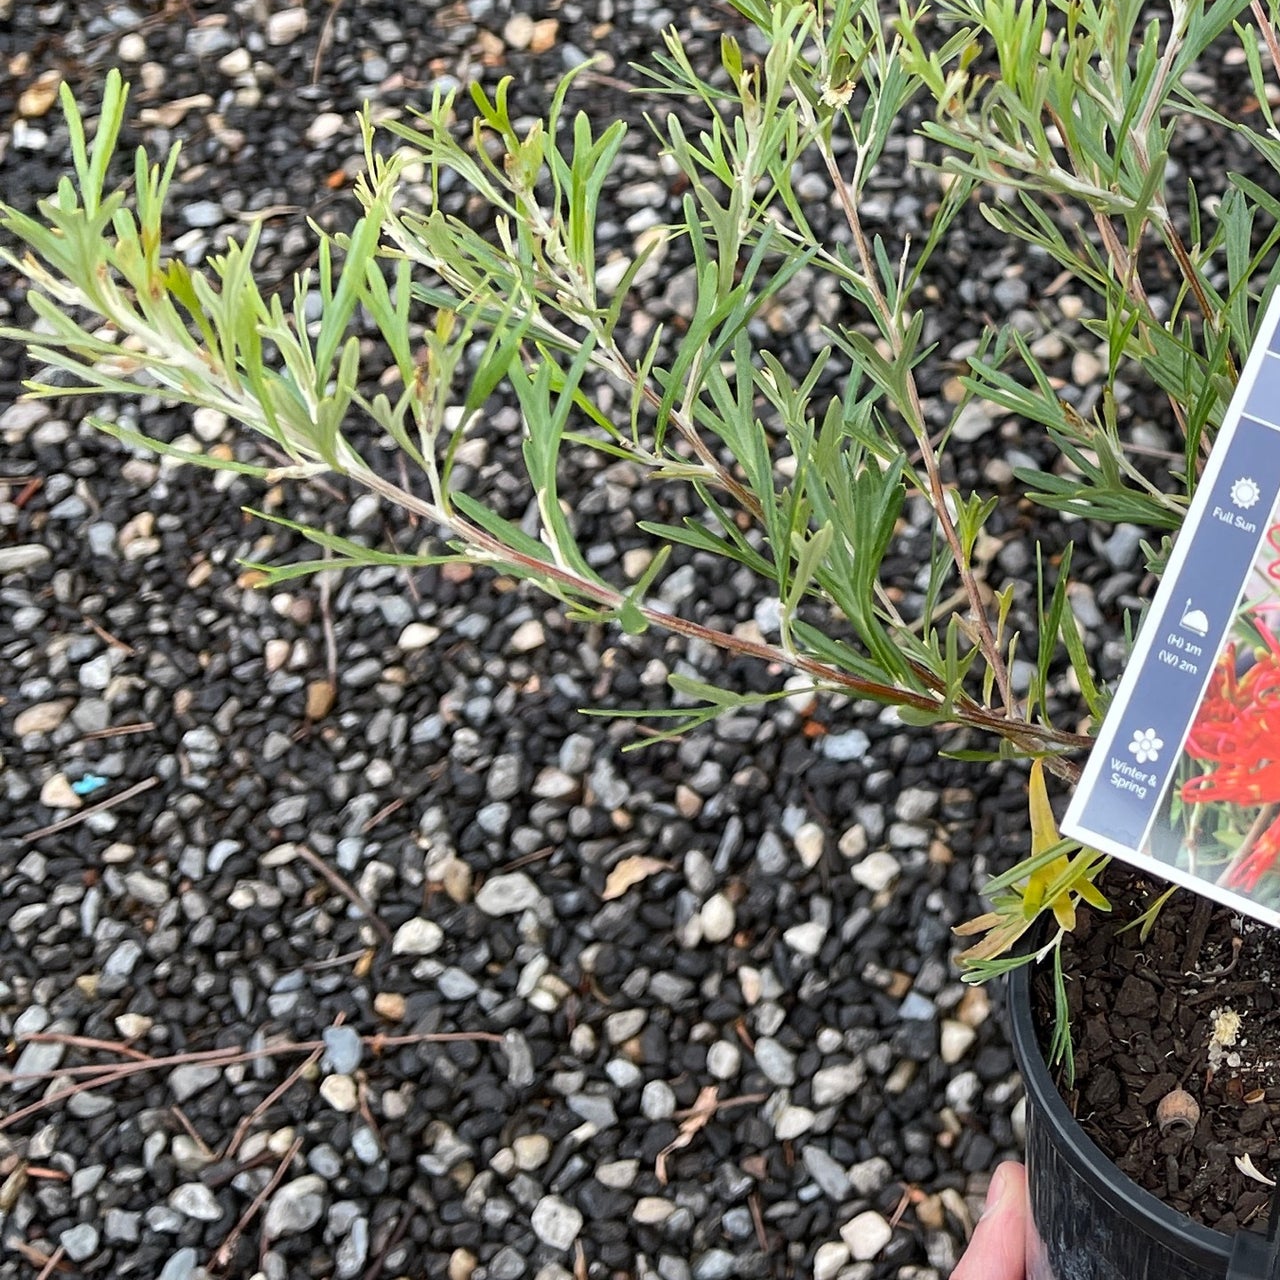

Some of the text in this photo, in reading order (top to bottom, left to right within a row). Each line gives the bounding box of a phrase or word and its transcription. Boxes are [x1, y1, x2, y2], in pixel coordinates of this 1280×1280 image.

[1212, 505, 1257, 533] Full Sun
[1167, 633, 1202, 657] (H) 1m
[1158, 649, 1198, 675] (W) 2m
[1110, 772, 1147, 800] Spring
[1111, 756, 1157, 788] Winter &
